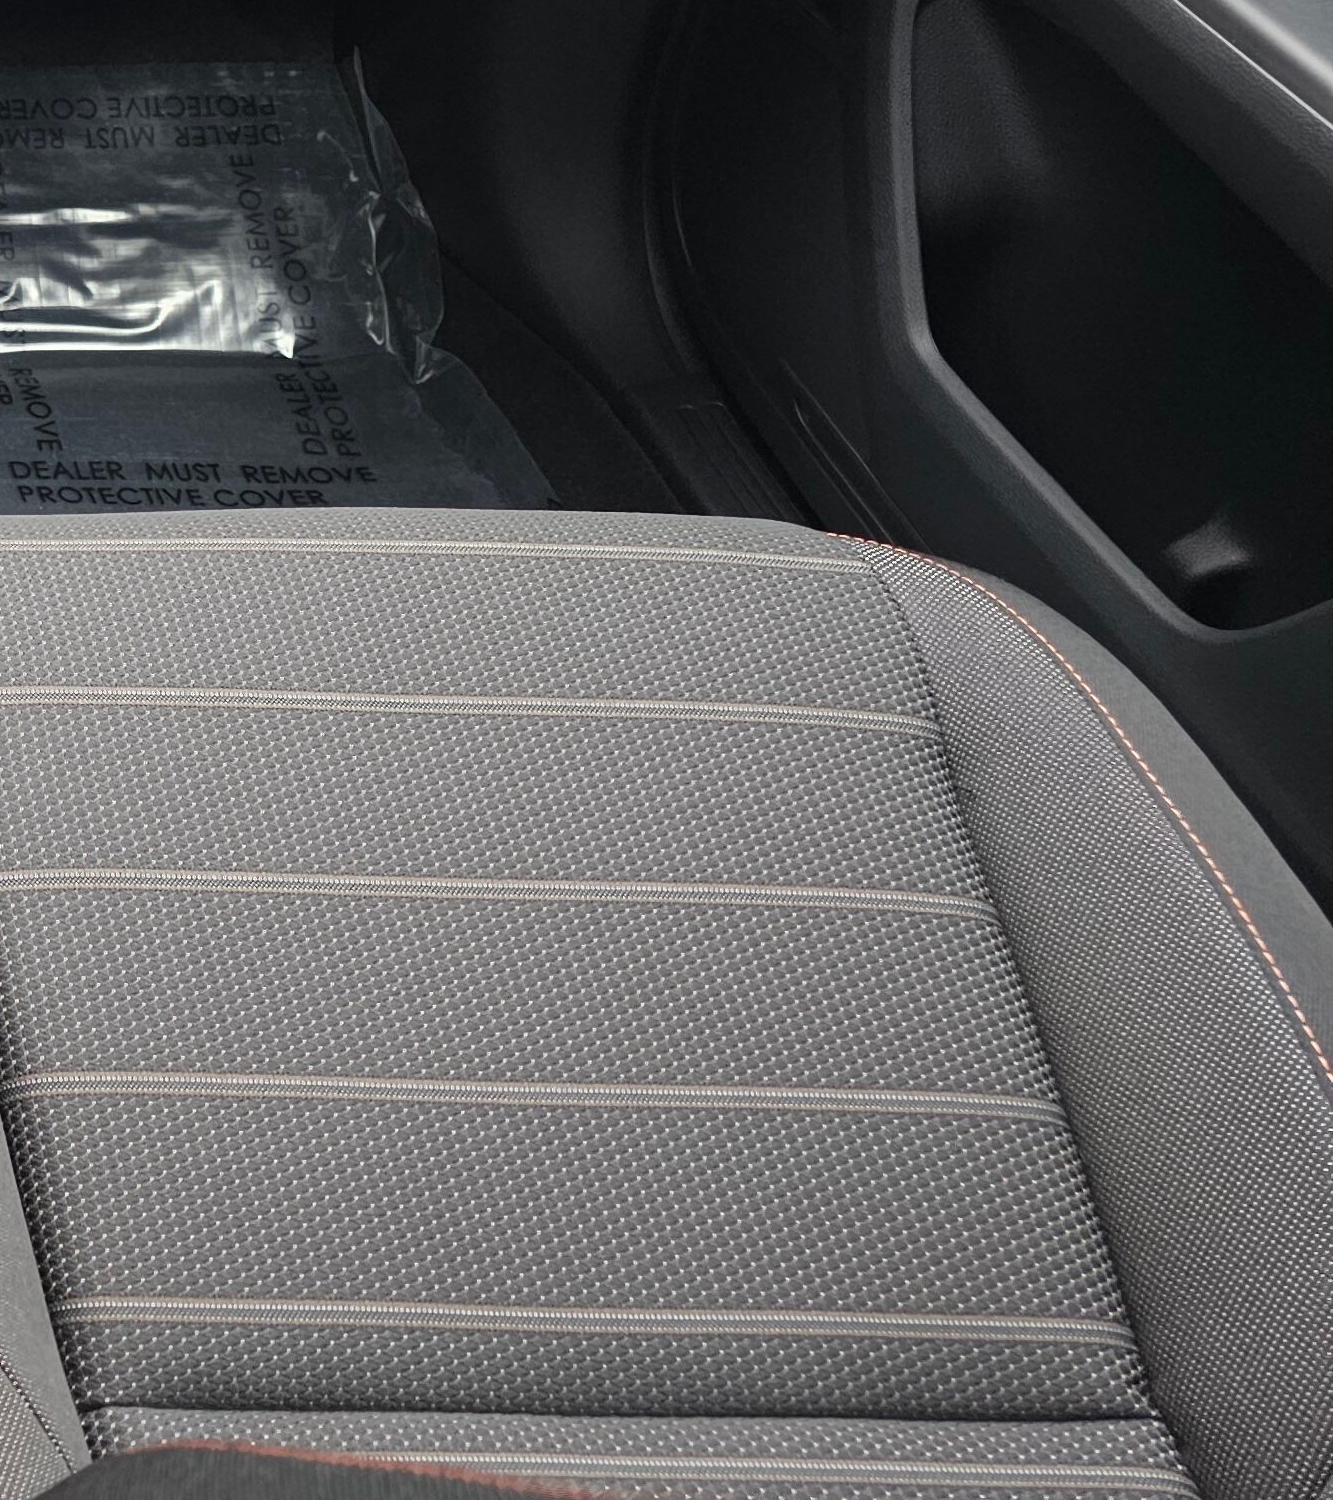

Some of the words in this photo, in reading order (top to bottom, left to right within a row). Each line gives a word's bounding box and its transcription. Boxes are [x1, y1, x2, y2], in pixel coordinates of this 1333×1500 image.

[107, 95, 277, 118] PROTECTIVE
[85, 126, 155, 149] MUST
[175, 124, 283, 148] DEALER
[229, 154, 274, 269] REMOVE
[273, 207, 316, 306] COVER
[8, 368, 63, 452] REMOVE
[275, 372, 327, 456] DEALER
[8, 461, 126, 481] DEALER
[145, 462, 223, 483] MUST
[240, 464, 378, 485] REMOVE
[18, 484, 205, 506] PROTECTIVE
[213, 486, 327, 507] COVER
